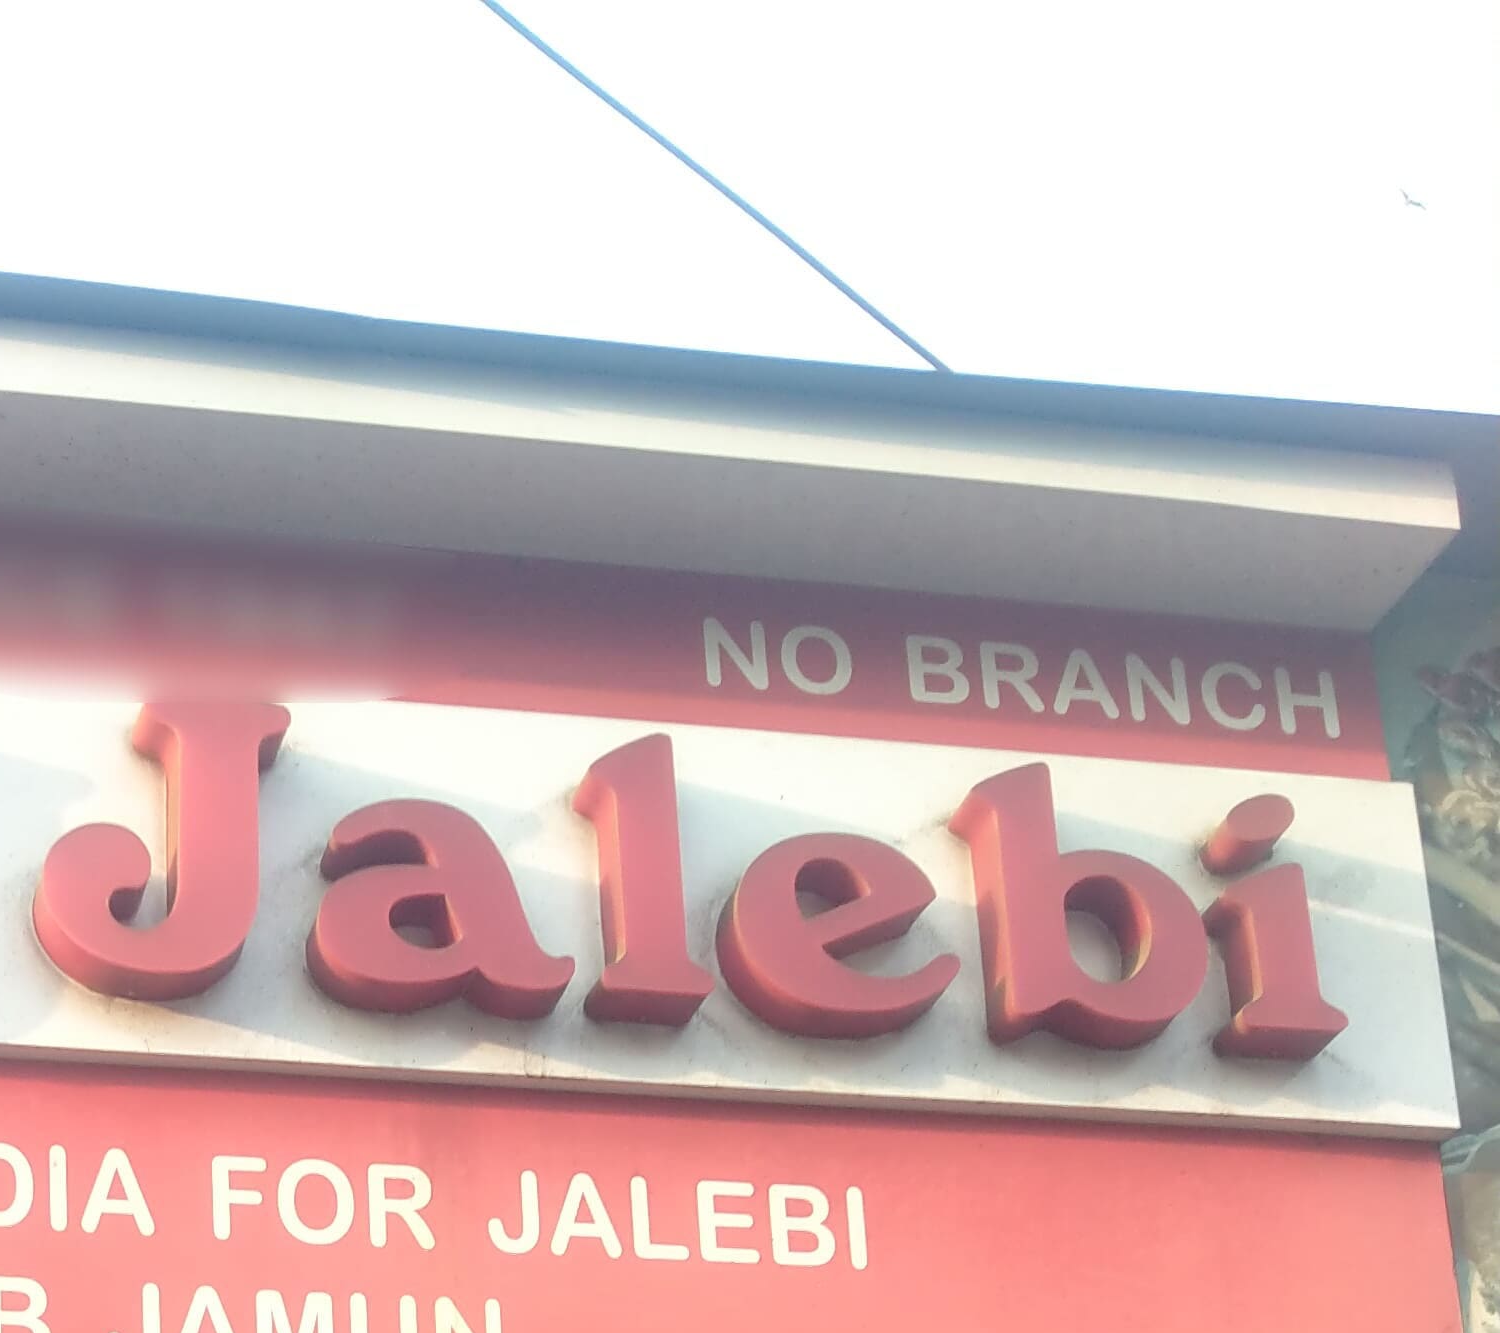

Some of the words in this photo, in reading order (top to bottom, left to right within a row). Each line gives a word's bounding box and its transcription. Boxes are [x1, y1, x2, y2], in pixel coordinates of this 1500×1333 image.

[703, 617, 853, 697] NO
[906, 634, 1342, 739] BRANCH
[32, 695, 1350, 1062] Jalebi
[211, 1155, 436, 1250] FOR
[487, 1169, 870, 1270] JALEBI
